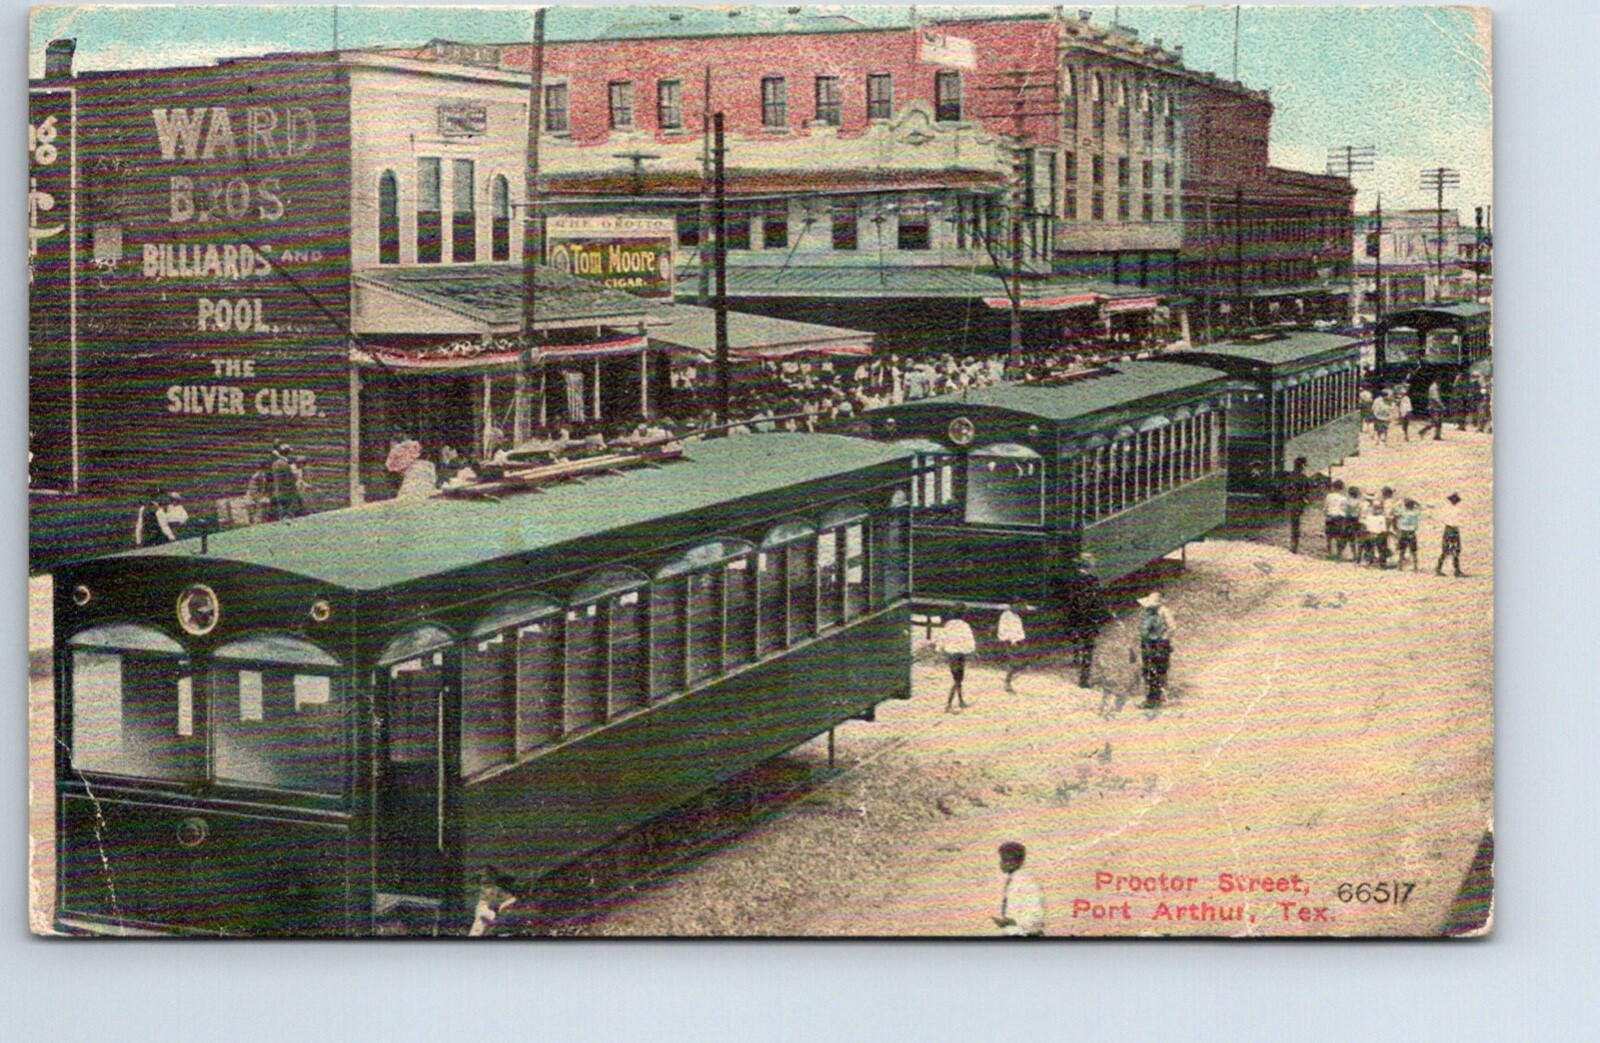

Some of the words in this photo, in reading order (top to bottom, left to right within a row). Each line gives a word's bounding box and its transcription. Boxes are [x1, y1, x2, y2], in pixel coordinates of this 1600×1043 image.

[152, 106, 316, 160] WARD
[143, 243, 273, 279] BILLIARDS
[280, 249, 323, 263] AND
[570, 244, 603, 274] Tom
[609, 244, 656, 273] Moore
[211, 359, 256, 378] THE
[166, 385, 246, 415] SILVER
